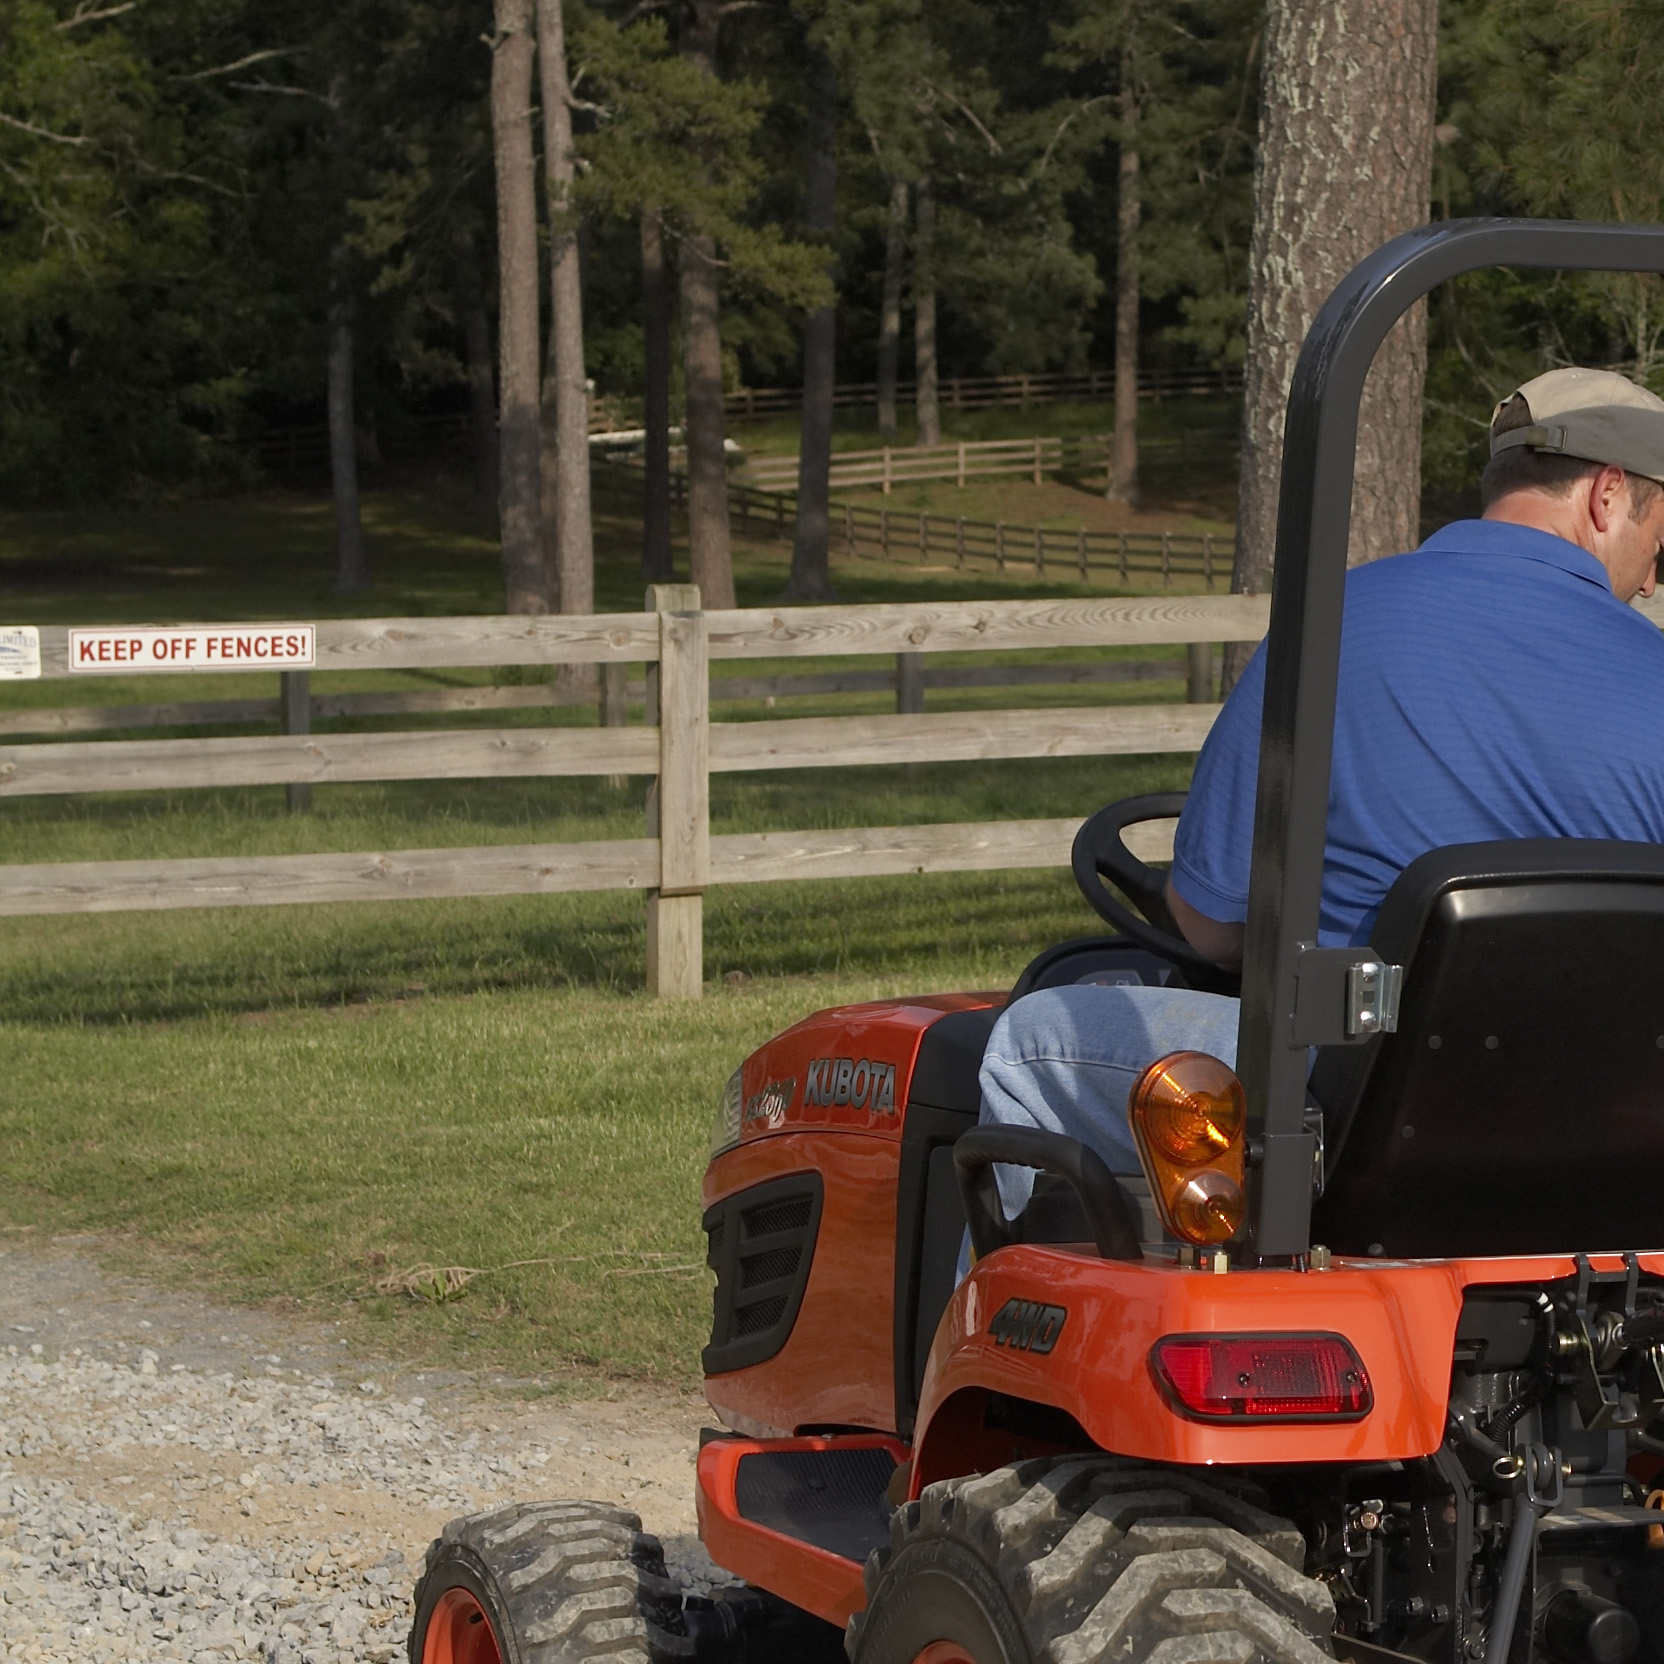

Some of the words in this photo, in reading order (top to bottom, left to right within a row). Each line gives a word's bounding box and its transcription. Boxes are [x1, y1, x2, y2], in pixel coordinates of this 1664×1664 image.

[79, 639, 143, 662] KEEP
[152, 638, 197, 660] OFF
[206, 635, 306, 659] FENCES!
[803, 1058, 896, 1115] KUBOTA
[988, 1297, 1067, 1354] 4WD
